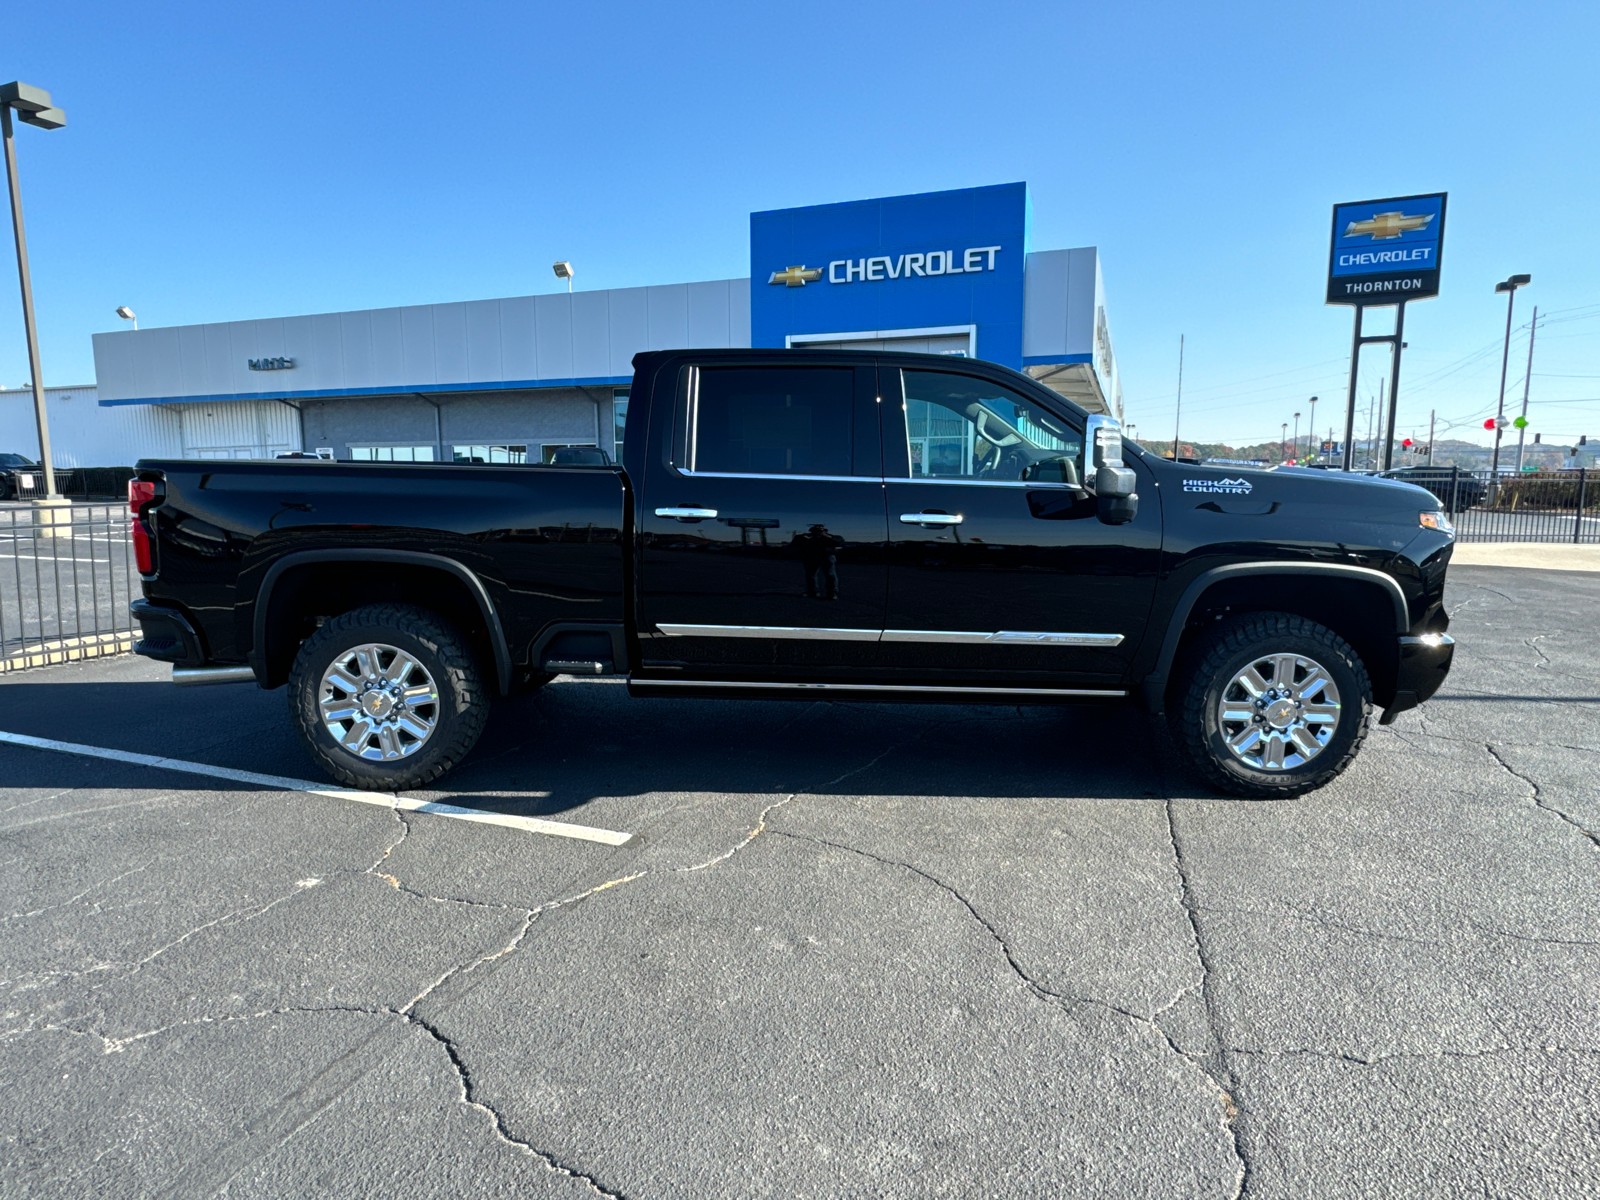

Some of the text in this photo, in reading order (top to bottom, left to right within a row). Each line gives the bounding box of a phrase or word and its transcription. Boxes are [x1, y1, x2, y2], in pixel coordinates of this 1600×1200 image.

[829, 246, 1001, 283] CHEVROLET
[1339, 247, 1432, 266] CHEVROLET
[1345, 278, 1422, 293] THORNTON
[1183, 486, 1252, 495] COUNTRY
